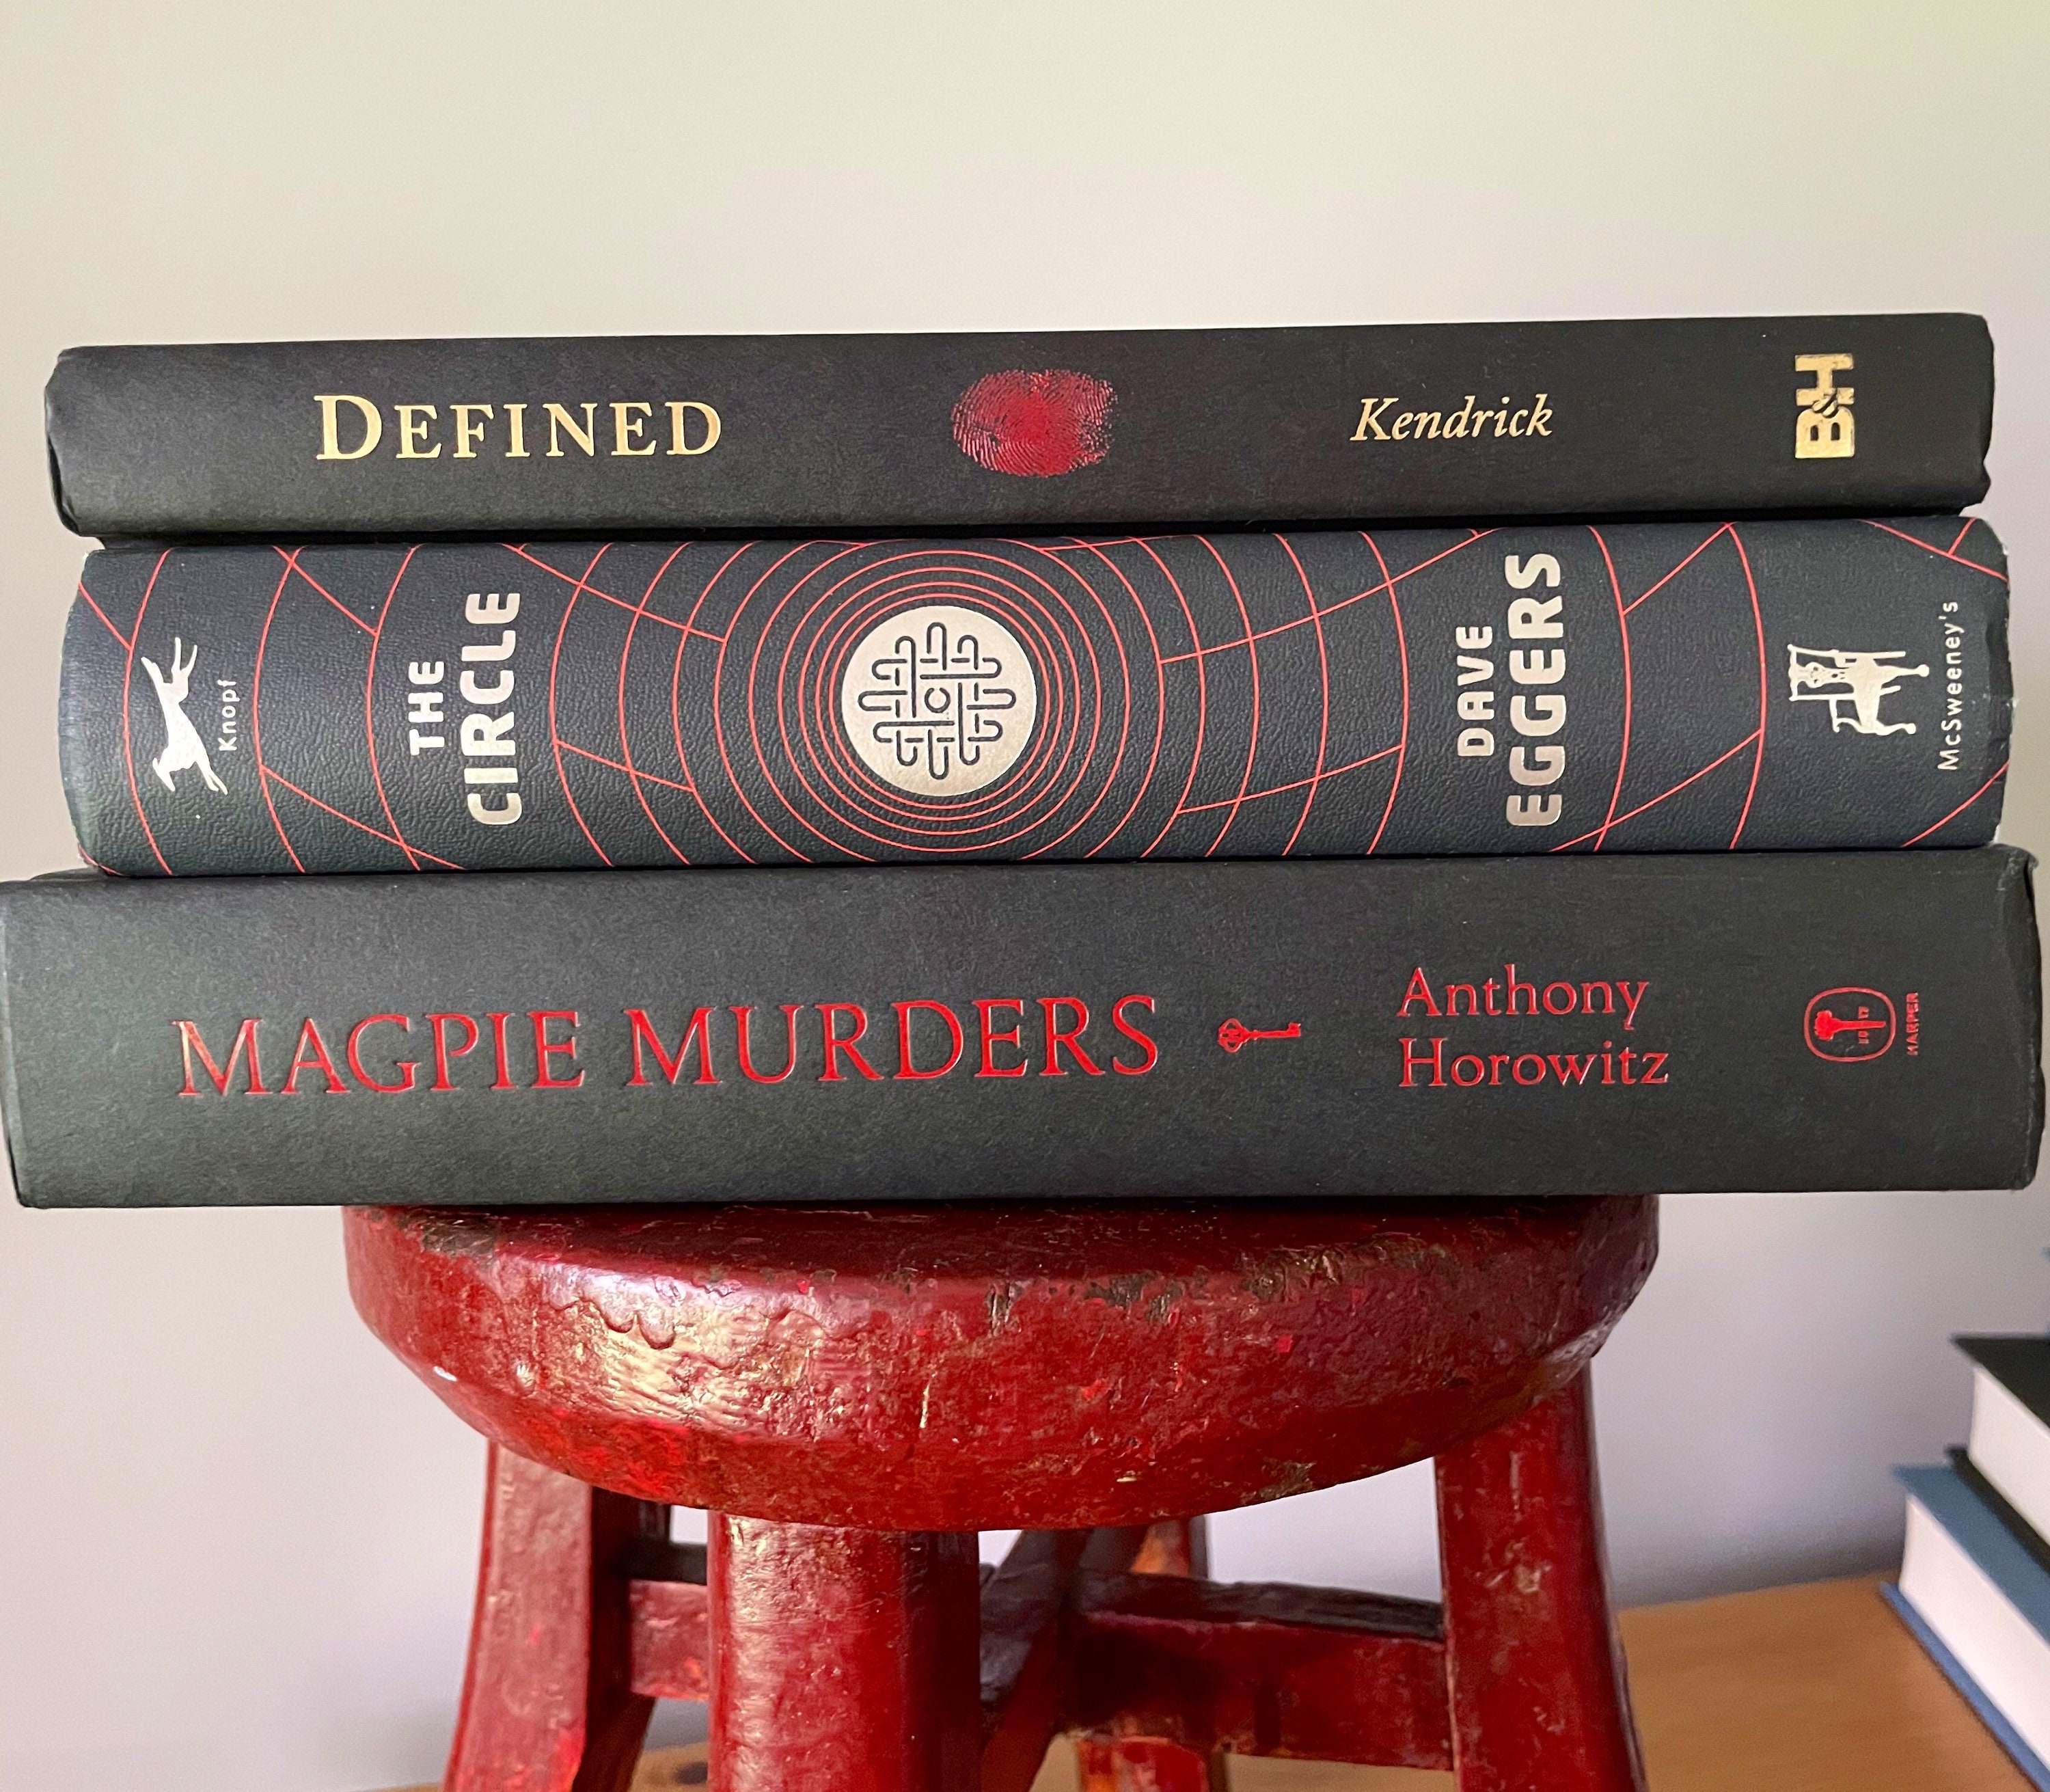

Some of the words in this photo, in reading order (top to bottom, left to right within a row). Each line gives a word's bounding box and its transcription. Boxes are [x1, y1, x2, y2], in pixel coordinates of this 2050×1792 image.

[314, 394, 722, 460] DEFINED
[1350, 393, 1553, 441] Kendrick
[217, 679, 240, 751] Knopf
[408, 661, 446, 755] THE
[460, 593, 522, 825] CIRCLE
[1456, 626, 1495, 757] DAVE
[1505, 553, 1566, 826] EGGERS
[1937, 601, 1965, 770] McSweeney's
[1396, 964, 1649, 1031] Anthony
[1906, 992, 1919, 1056] HARPER
[172, 1009, 585, 1097] MAGPIE
[623, 994, 1159, 1085] MURDERS
[1398, 1037, 1669, 1087] Horowitz
